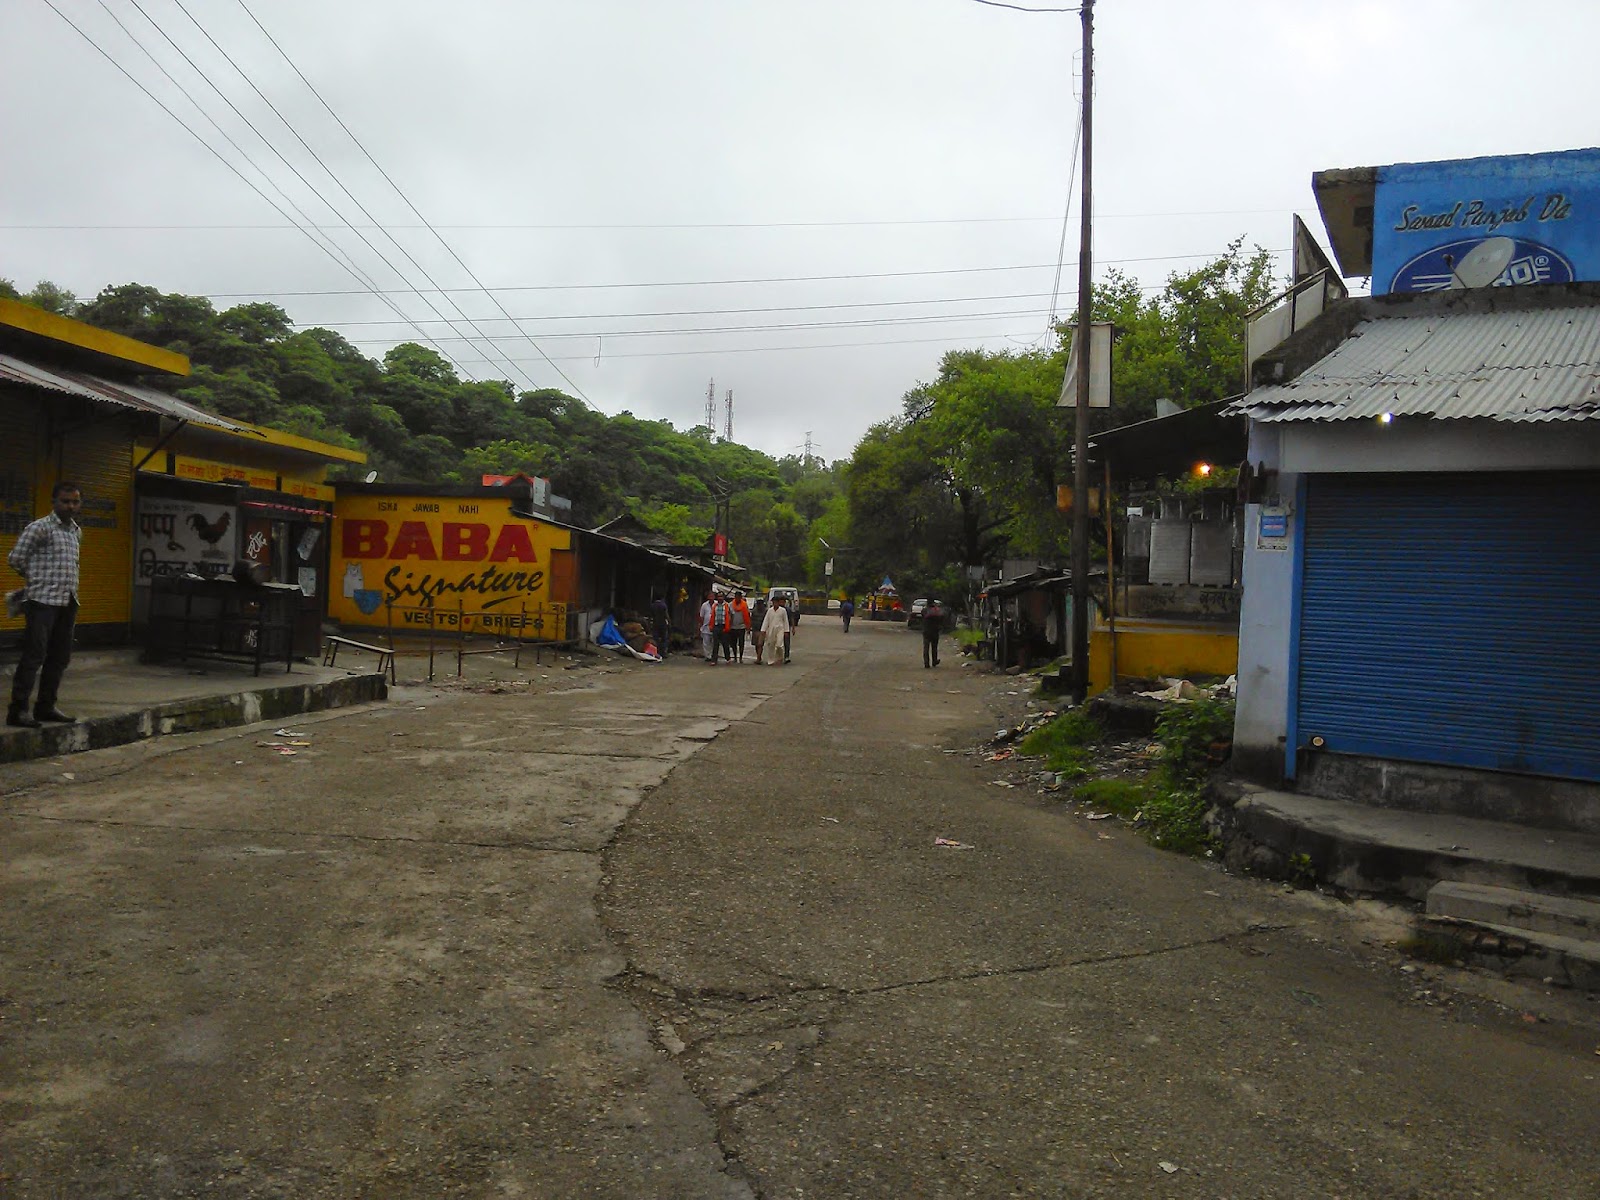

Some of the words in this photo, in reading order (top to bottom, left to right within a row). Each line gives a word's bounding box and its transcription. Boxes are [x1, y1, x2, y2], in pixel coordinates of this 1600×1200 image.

[1461, 197, 1535, 232] Panjab
[1538, 193, 1572, 220] Da
[378, 502, 398, 511] ISKA
[412, 503, 440, 513] JAWAB
[458, 505, 479, 514] NAHI
[342, 518, 538, 563] BABA
[384, 564, 544, 607] Signature
[403, 611, 458, 625] VESTS
[483, 616, 544, 629] BRIEFS
